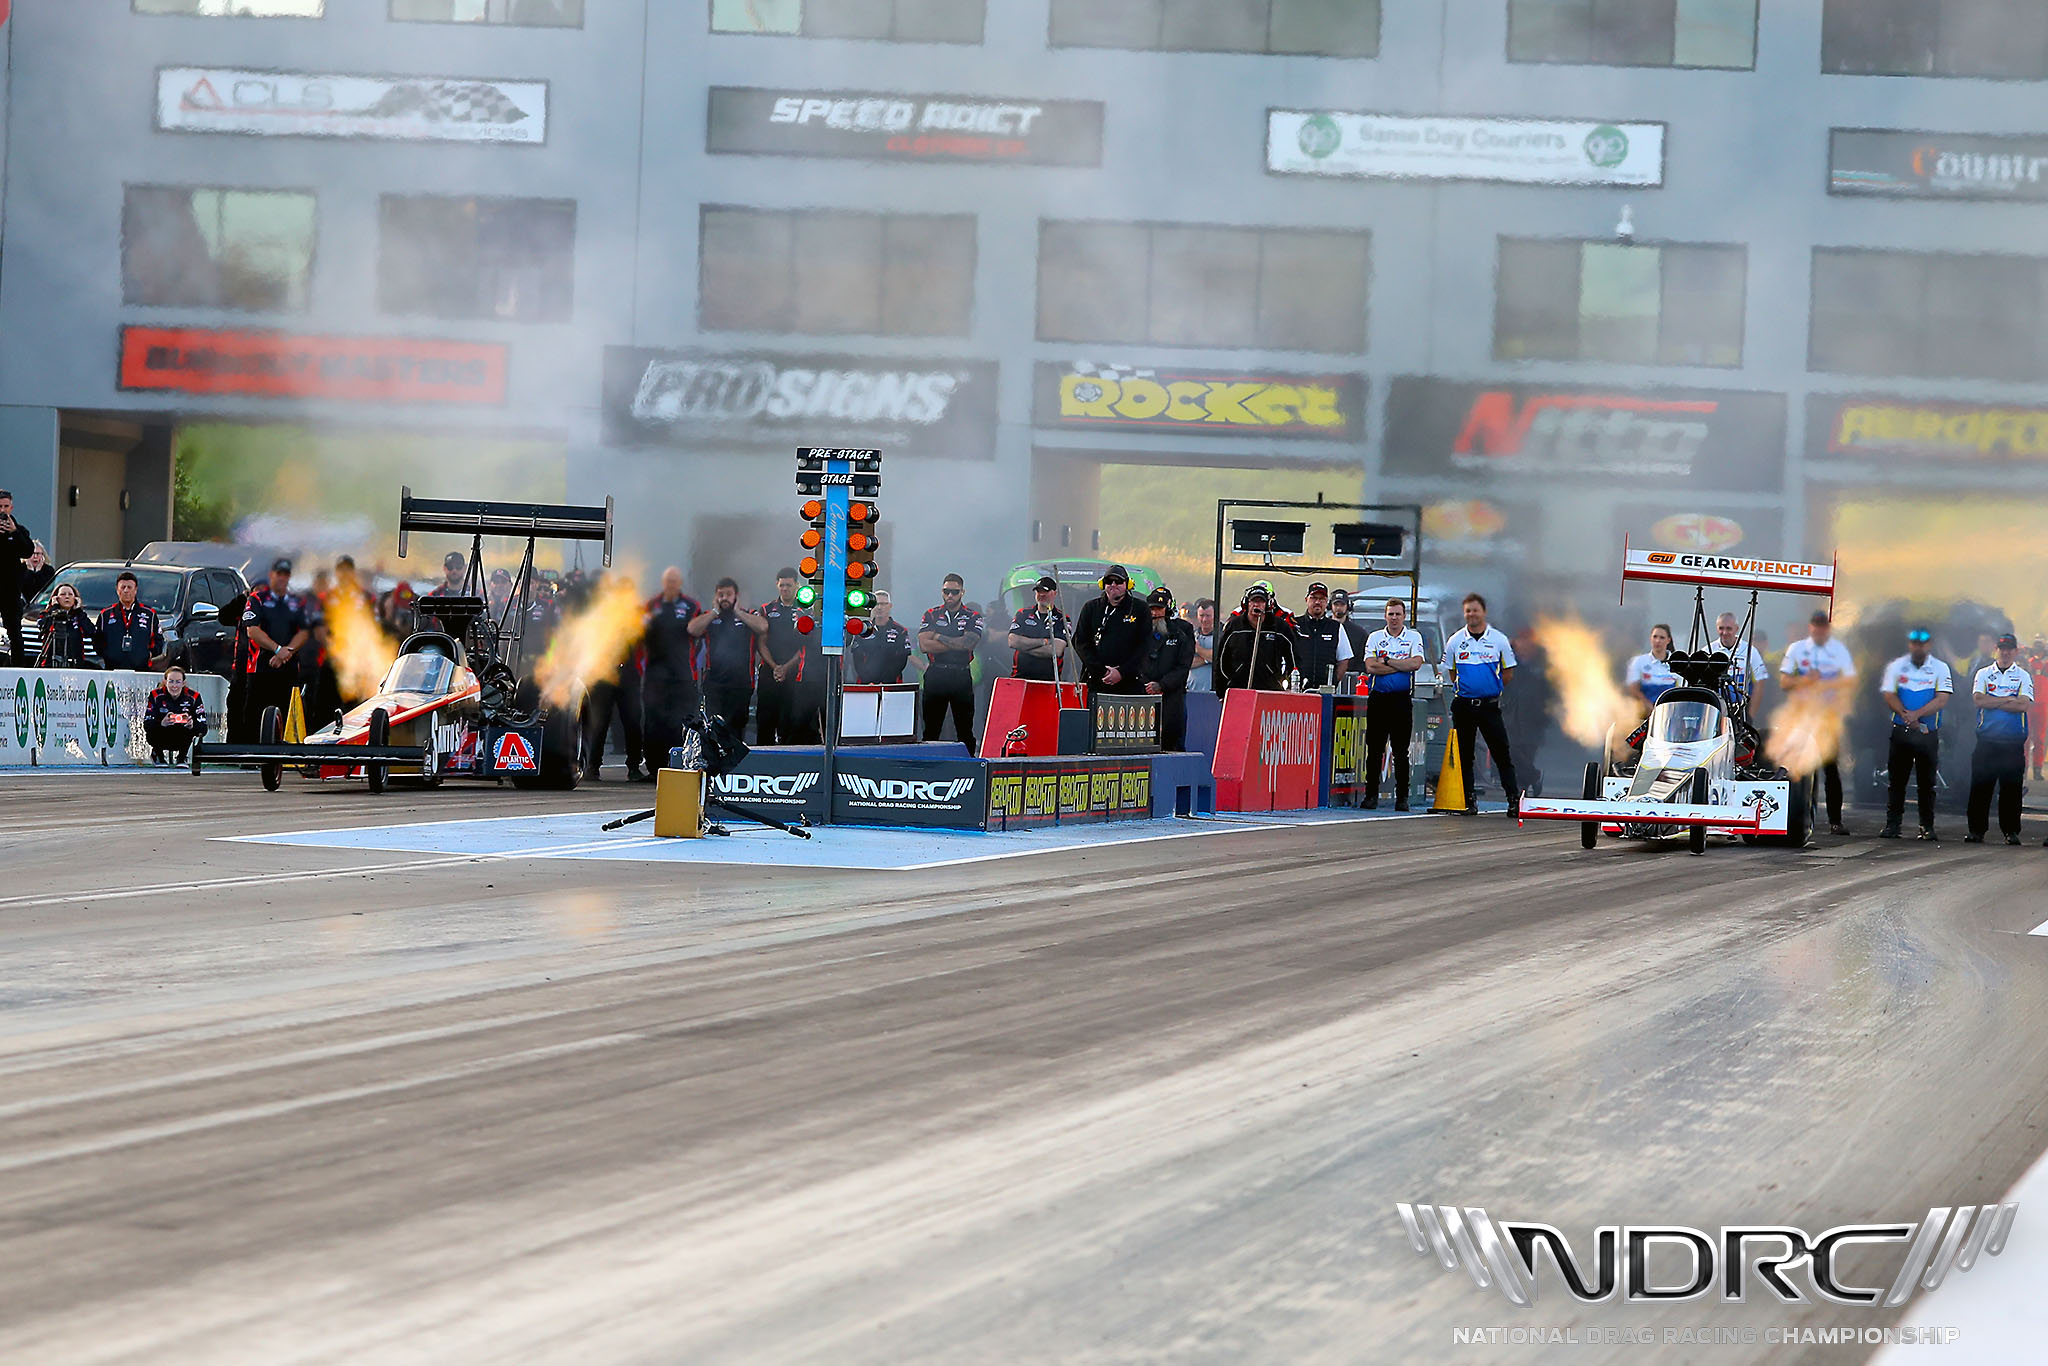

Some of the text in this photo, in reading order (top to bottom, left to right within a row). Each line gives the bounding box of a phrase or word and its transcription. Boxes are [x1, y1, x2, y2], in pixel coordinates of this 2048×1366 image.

[770, 97, 913, 132] SPEED
[1359, 124, 1566, 150] Same Day Couriers
[808, 448, 873, 460] PRE-STAGE
[820, 474, 854, 484] STAGE
[1681, 555, 1813, 576] GEARWRENCH
[500, 755, 530, 764] ATLANTIC
[1331, 716, 1368, 784] AEROFL
[859, 777, 953, 801] NDRC
